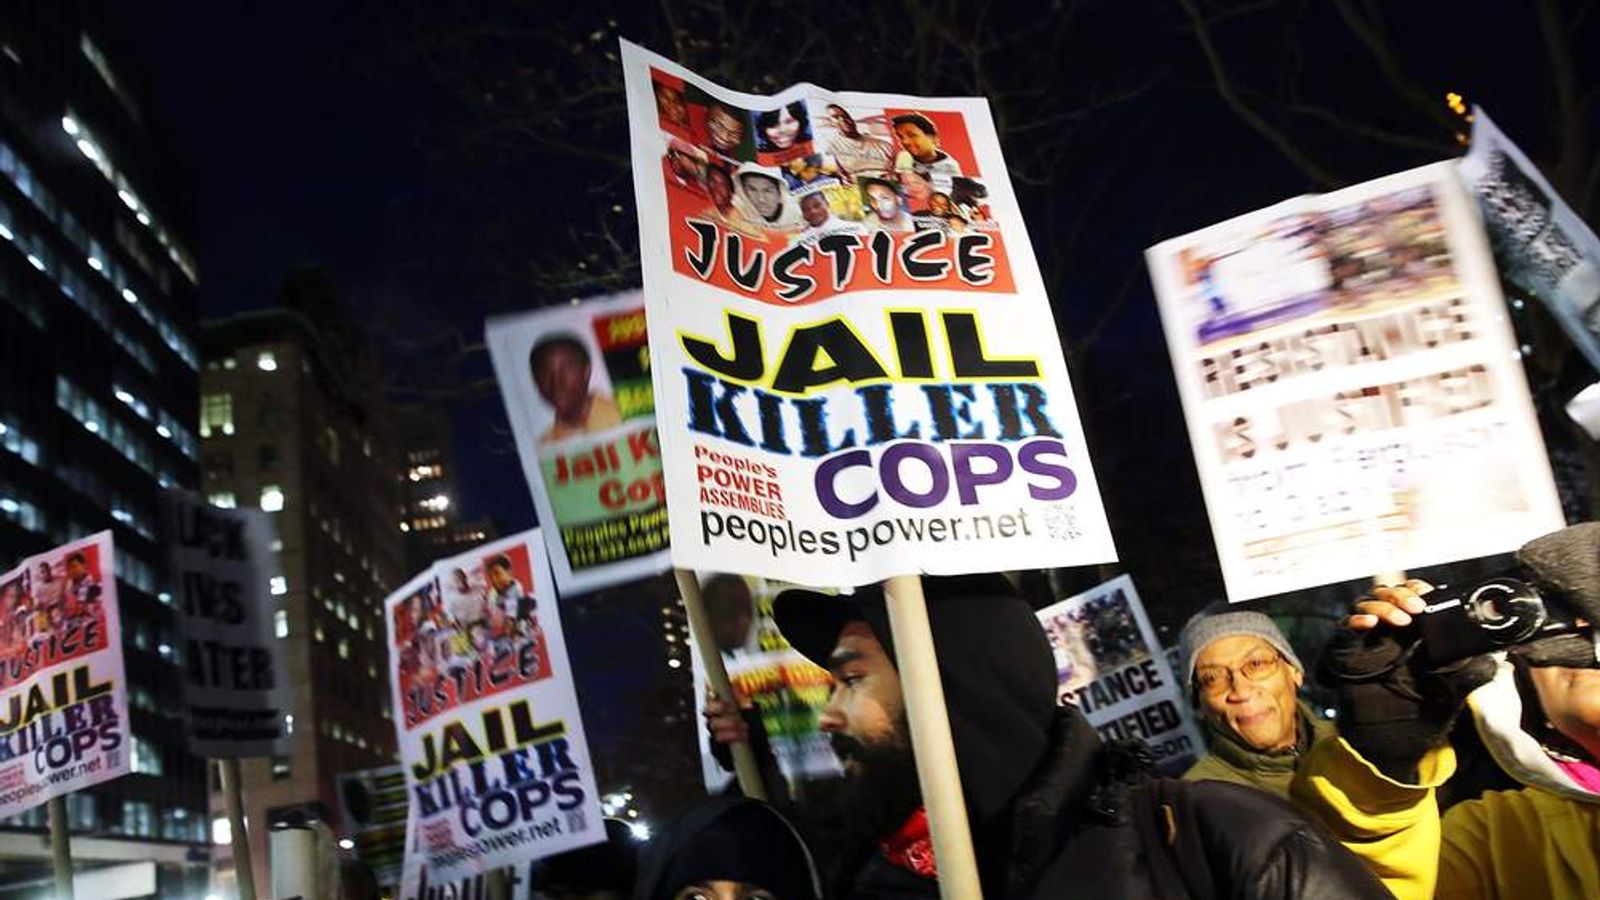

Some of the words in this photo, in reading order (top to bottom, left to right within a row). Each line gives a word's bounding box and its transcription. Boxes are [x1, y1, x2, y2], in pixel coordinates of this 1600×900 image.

[685, 217, 995, 300] JUSTICE
[678, 309, 1044, 396] JAIL
[681, 367, 1064, 458] KILLER
[694, 446, 778, 478] People's
[697, 464, 783, 501] POWER
[814, 441, 1078, 520] COPS
[700, 486, 786, 520] ASSEMBLIES
[35, 718, 121, 774] COPS
[412, 699, 567, 780] JAIL
[414, 738, 578, 818] KILLER
[460, 771, 585, 837] COPS
